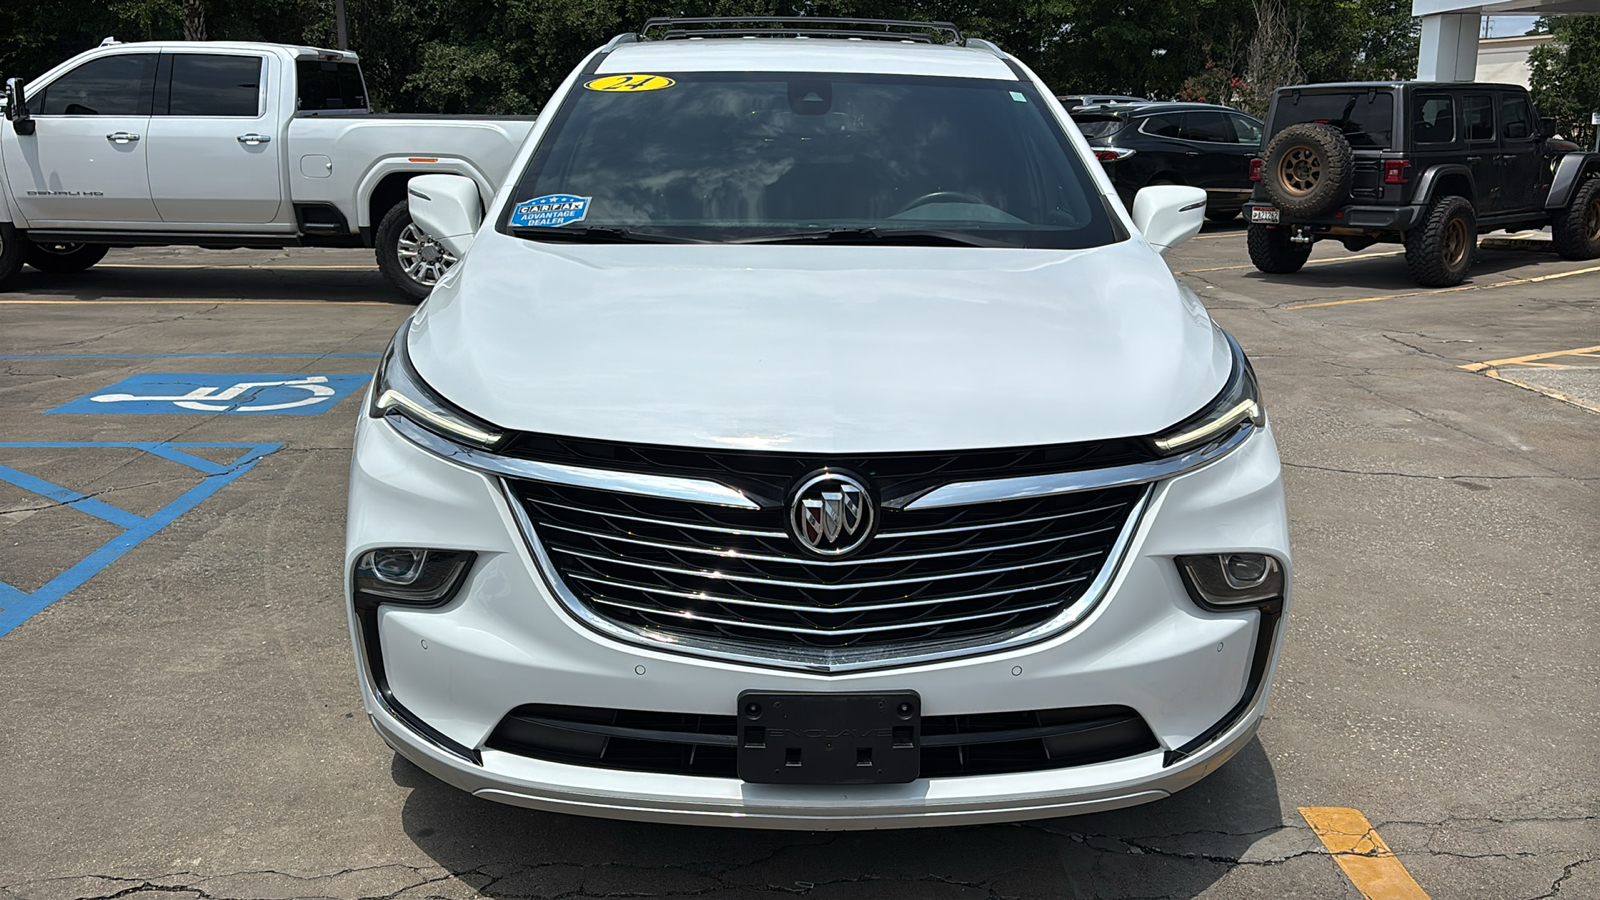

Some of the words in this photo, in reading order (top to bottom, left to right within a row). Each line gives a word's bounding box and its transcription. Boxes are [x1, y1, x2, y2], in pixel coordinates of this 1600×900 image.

[602, 76, 656, 90] 24
[519, 202, 583, 213] CARFAX
[521, 210, 576, 220] ADVANTAGE
[528, 217, 564, 226] DEALER
[766, 728, 892, 738] ENCLAVE
